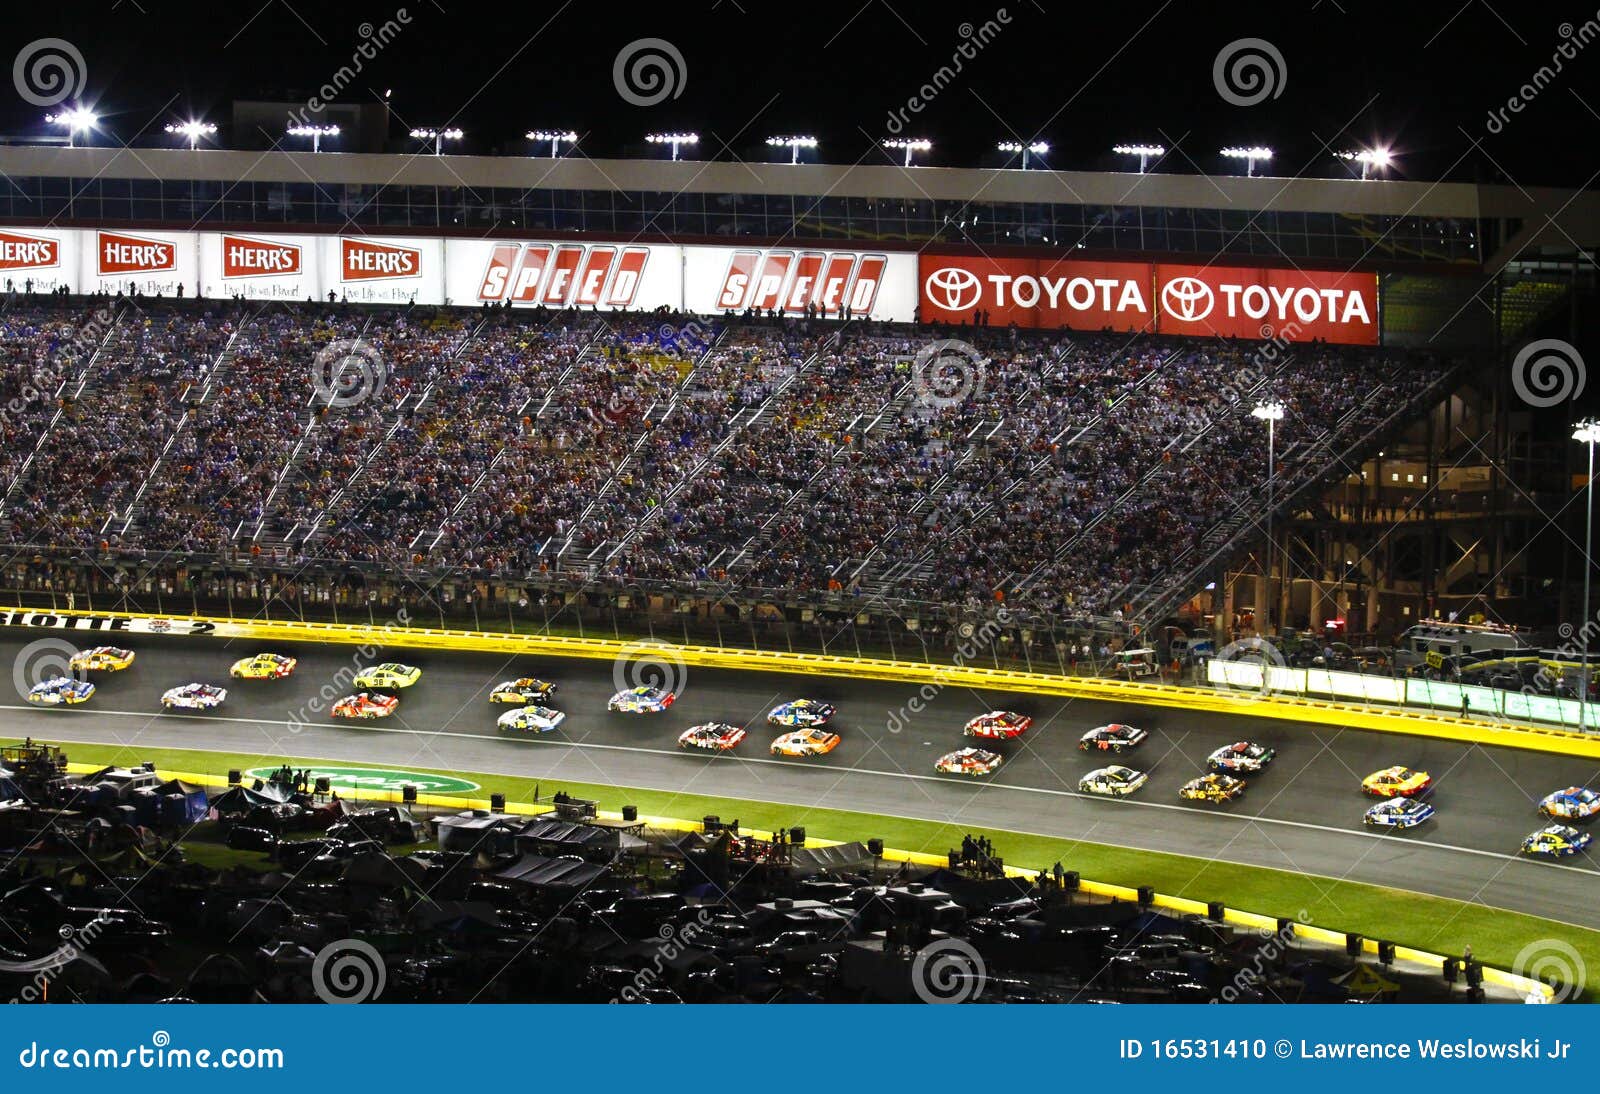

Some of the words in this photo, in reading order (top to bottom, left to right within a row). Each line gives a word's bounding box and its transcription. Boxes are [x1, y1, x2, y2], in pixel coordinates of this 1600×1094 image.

[104, 242, 169, 267] HERR'S
[228, 246, 294, 270] HERR'S
[348, 249, 413, 274] HERR'S
[482, 266, 639, 301] SPEED
[721, 274, 876, 311] SPEED
[988, 275, 1147, 313] TOYOTA
[1220, 284, 1371, 324] TOYOTA
[0, 612, 132, 631] LOTTE
